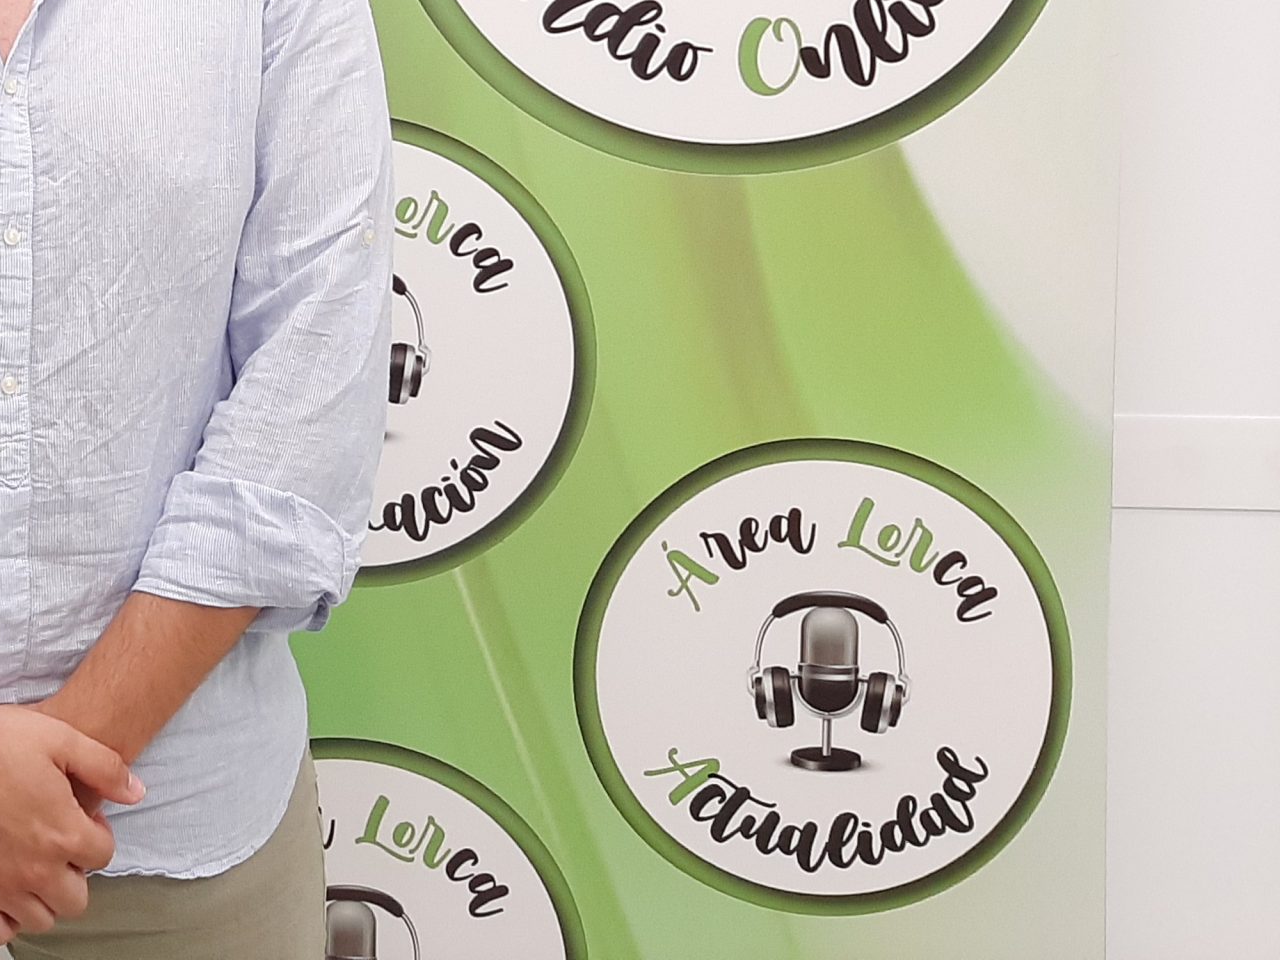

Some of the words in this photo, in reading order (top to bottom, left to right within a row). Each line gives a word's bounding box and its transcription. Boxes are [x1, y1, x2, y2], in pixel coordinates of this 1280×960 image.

[394, 189, 514, 293] orca
[661, 507, 817, 612] Área
[837, 497, 998, 623] Lorca
[354, 794, 510, 918] Lorca
[643, 746, 990, 874] Actualidad
